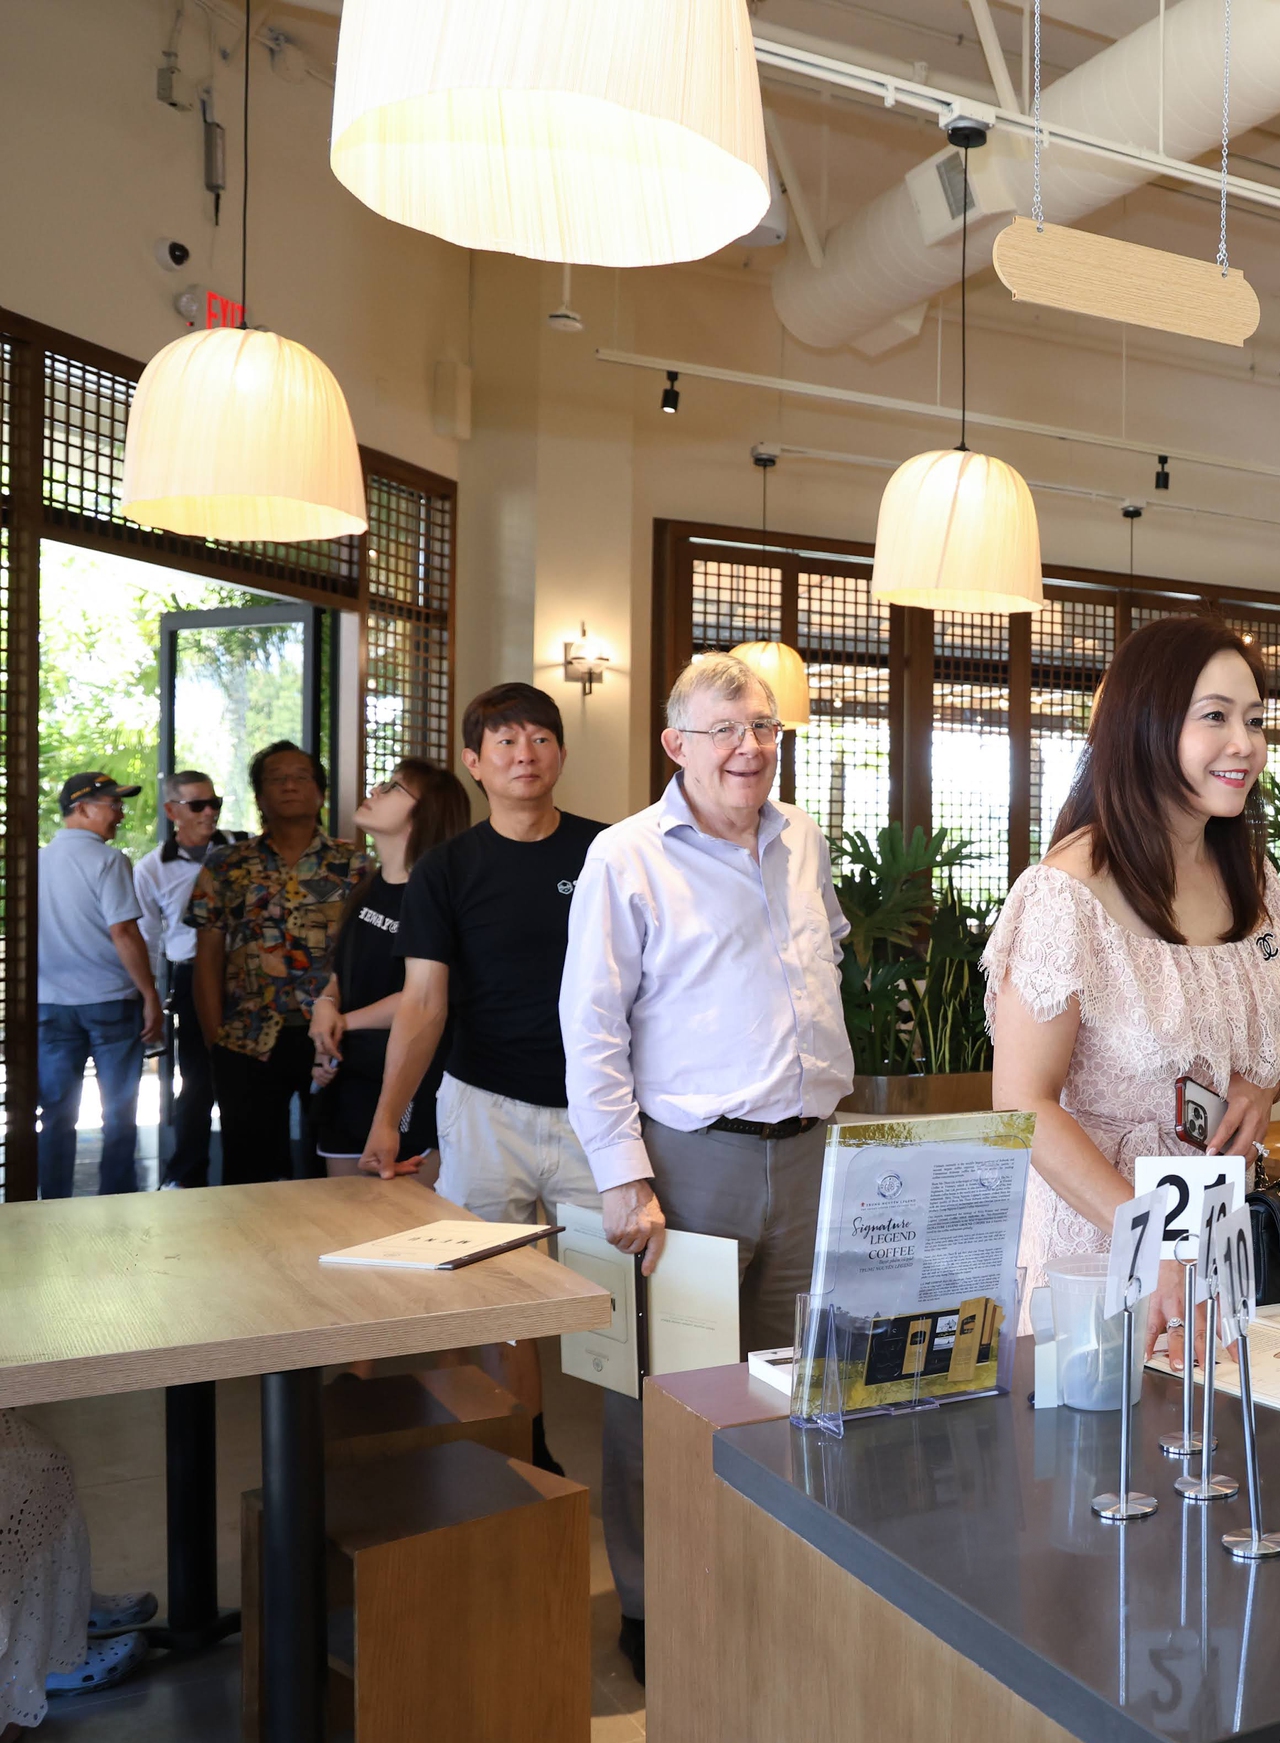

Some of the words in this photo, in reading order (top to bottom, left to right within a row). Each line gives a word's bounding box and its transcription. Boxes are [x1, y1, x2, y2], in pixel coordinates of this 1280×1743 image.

[1156, 1174, 1226, 1241] 2
[852, 1216, 912, 1239] Signature
[870, 1230, 917, 1245] LEGEND
[868, 1245, 915, 1260] COFFEE
[1128, 1210, 1151, 1282] 7
